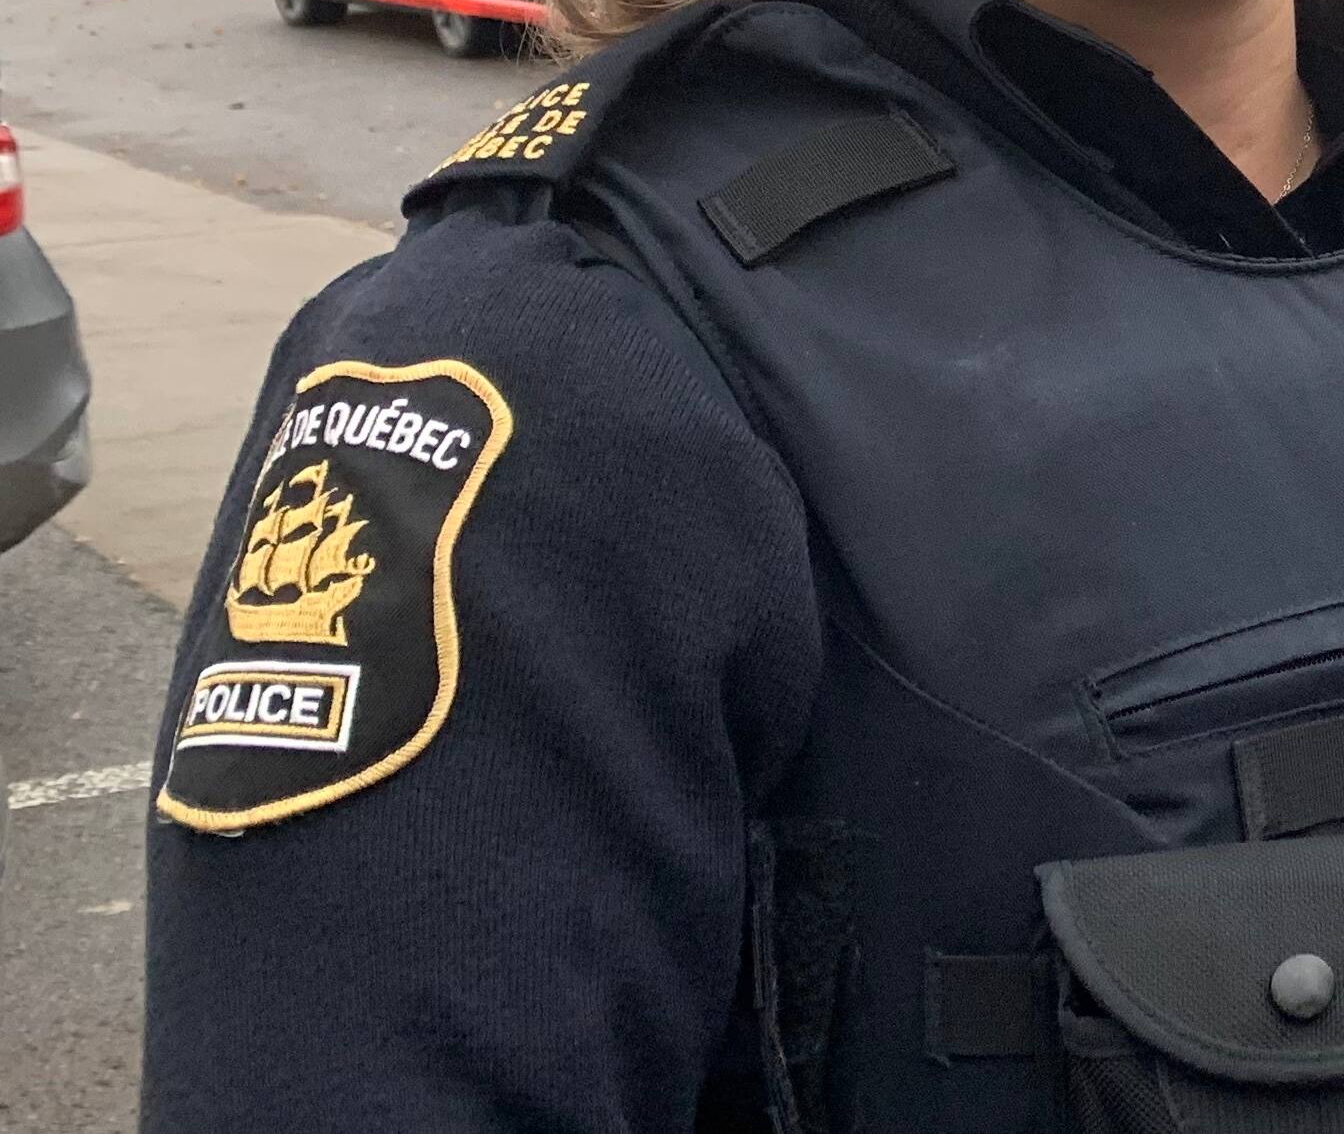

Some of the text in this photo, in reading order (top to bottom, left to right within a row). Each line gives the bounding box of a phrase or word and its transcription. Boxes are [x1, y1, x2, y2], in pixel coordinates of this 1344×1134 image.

[291, 404, 325, 449] DE
[323, 398, 471, 470] QUÉBEC
[186, 683, 324, 727] POLICE
